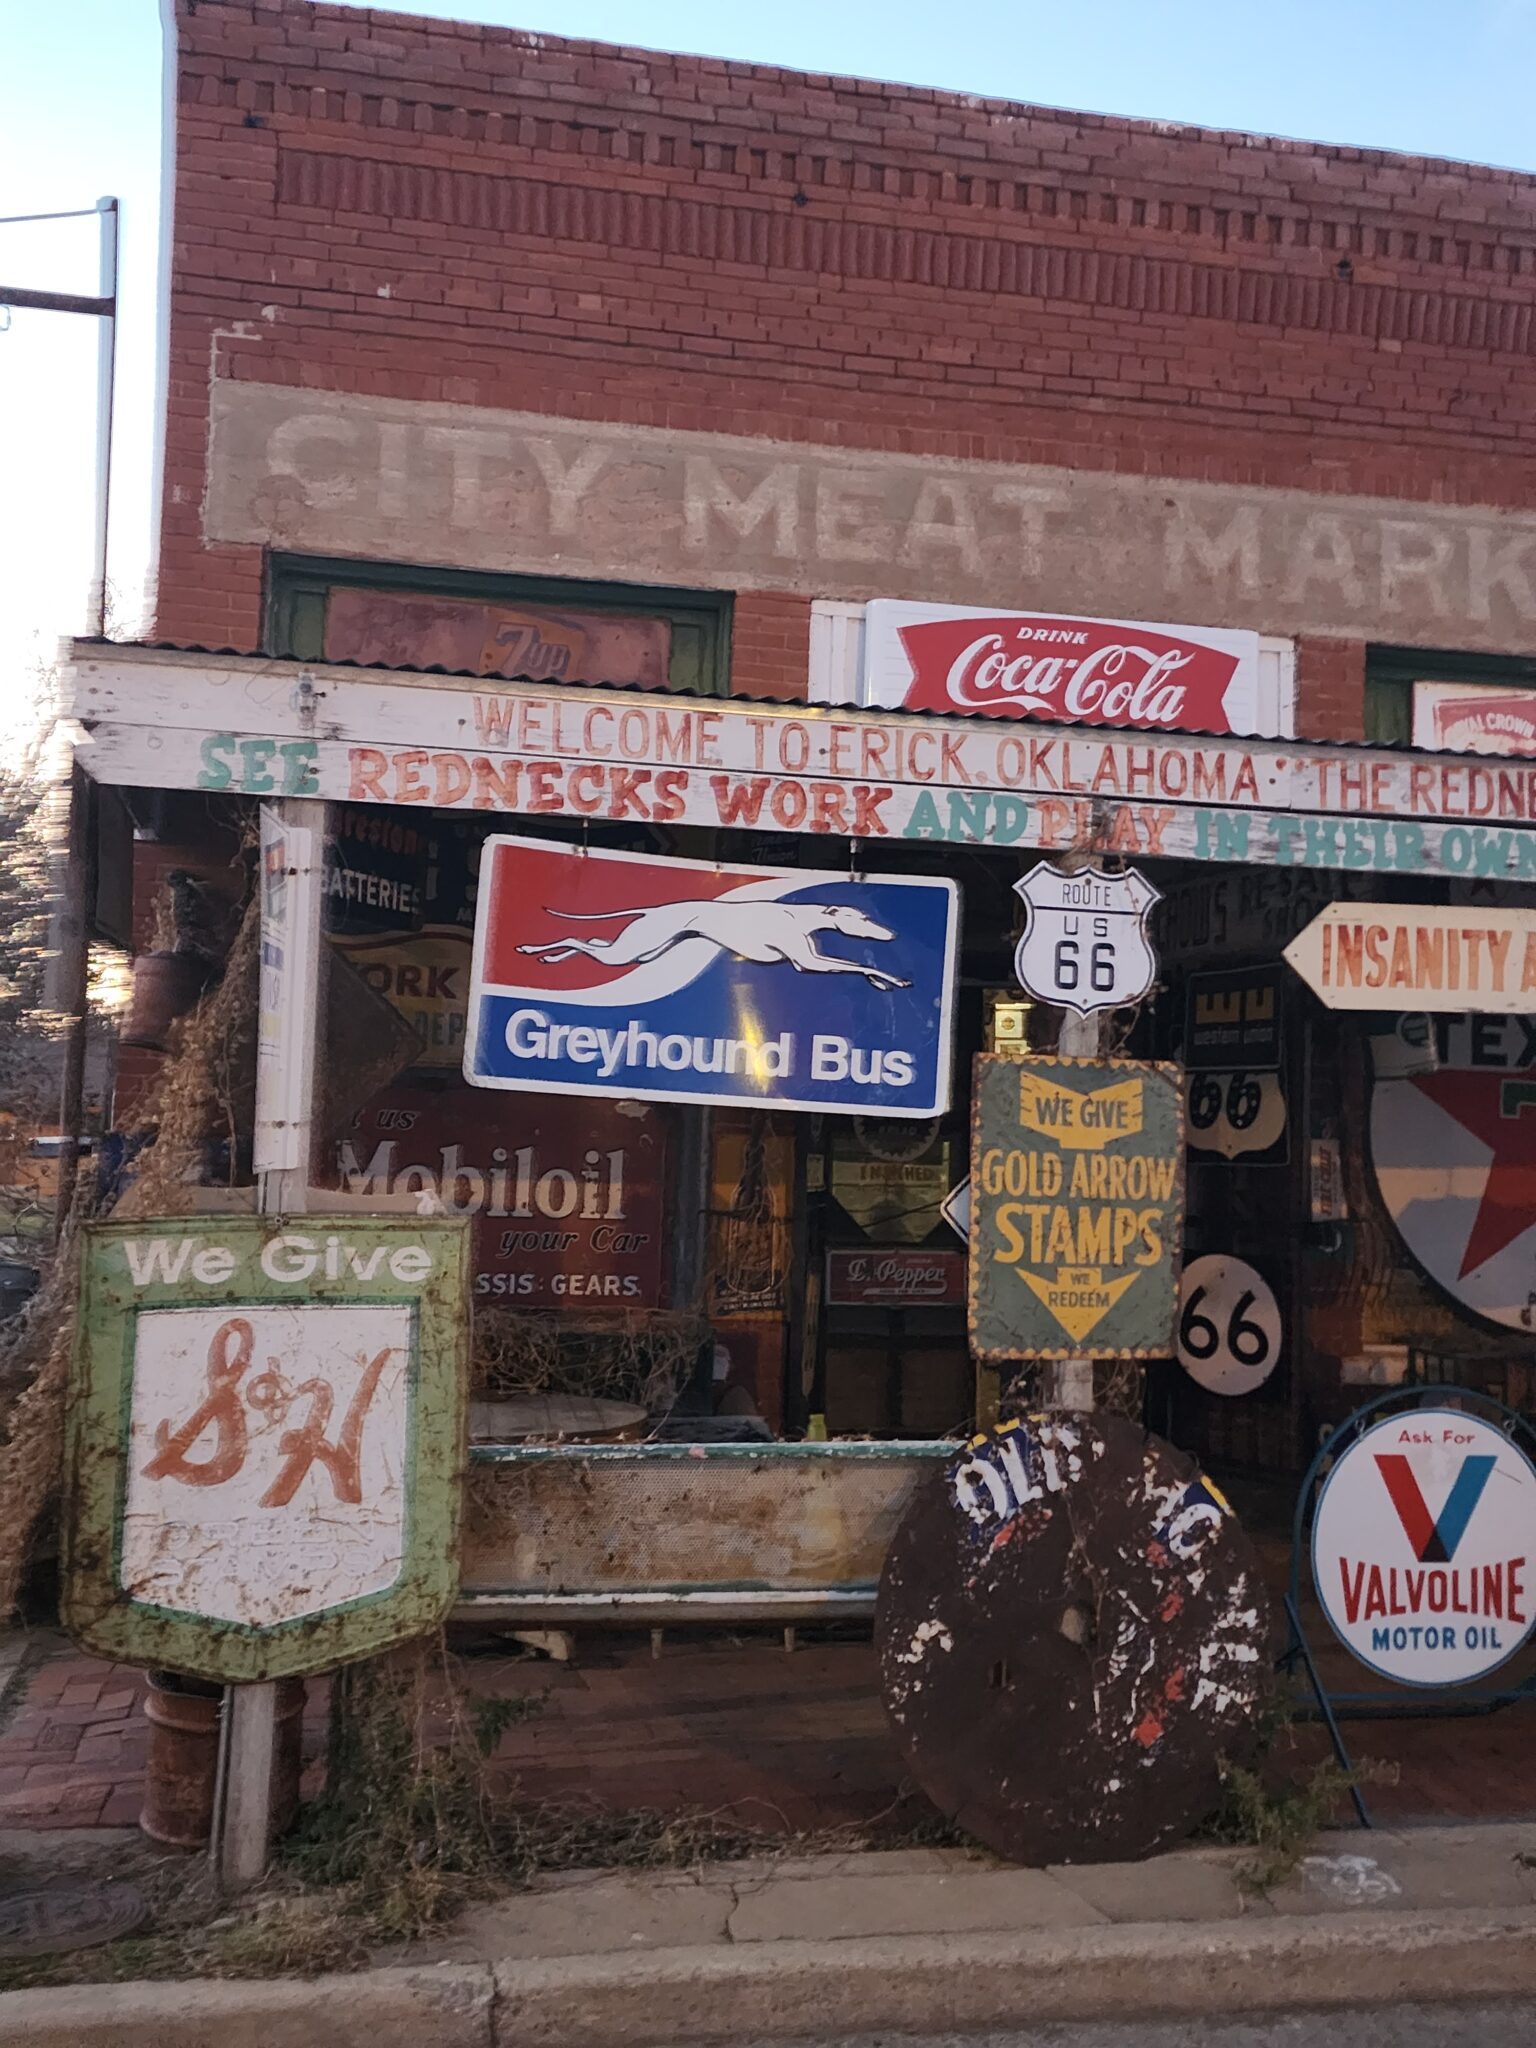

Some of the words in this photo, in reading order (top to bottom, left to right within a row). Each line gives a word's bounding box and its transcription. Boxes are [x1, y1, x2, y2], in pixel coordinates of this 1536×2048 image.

[266, 414, 612, 538] CITY
[683, 453, 1070, 579] MEAT
[1166, 501, 1536, 623] MARK
[1017, 626, 1090, 645] DRINK
[946, 633, 1197, 723] Coca-Cola
[473, 696, 723, 768] WELCOME
[745, 716, 810, 772] TO
[996, 737, 1260, 803] OKLAHOMA
[1486, 712, 1535, 739] CROWN
[198, 734, 320, 796] SEE
[348, 746, 690, 824] REDNECKS
[709, 772, 893, 836] WORK
[902, 789, 1028, 844] AND
[1035, 798, 1176, 856] PLAY
[1193, 809, 1252, 859] IN
[1268, 815, 1426, 871] THEIR
[1061, 883, 1112, 907] ROUTE
[1063, 916, 1109, 938] US
[362, 962, 461, 999] ORK
[1053, 940, 1116, 993] 66
[1321, 923, 1513, 992] INSANITY
[504, 1008, 792, 1077] Greyhound
[811, 1034, 915, 1086] Bus
[1035, 1096, 1073, 1127] WE
[1080, 1097, 1128, 1129] GIVE
[1188, 1073, 1262, 1131] 66
[334, 1138, 629, 1220] Mobiloil
[981, 1148, 1063, 1197] GOLD
[1068, 1152, 1177, 1202] ARROW
[122, 1237, 237, 1286] We
[259, 1235, 433, 1284] Give
[496, 1228, 579, 1258] your
[590, 1224, 650, 1255] Car
[993, 1202, 1164, 1267] STAMPS
[874, 1258, 946, 1290] Pepper
[1048, 1288, 1111, 1308] REDEEM
[1070, 1272, 1091, 1286] WE
[1179, 1286, 1270, 1367] 66
[1398, 1429, 1433, 1445] Ask
[1442, 1429, 1476, 1445] For
[1339, 1556, 1526, 1625] VALVOLINE
[1372, 1626, 1457, 1651] MOTOR
[1465, 1626, 1503, 1650] OIL
